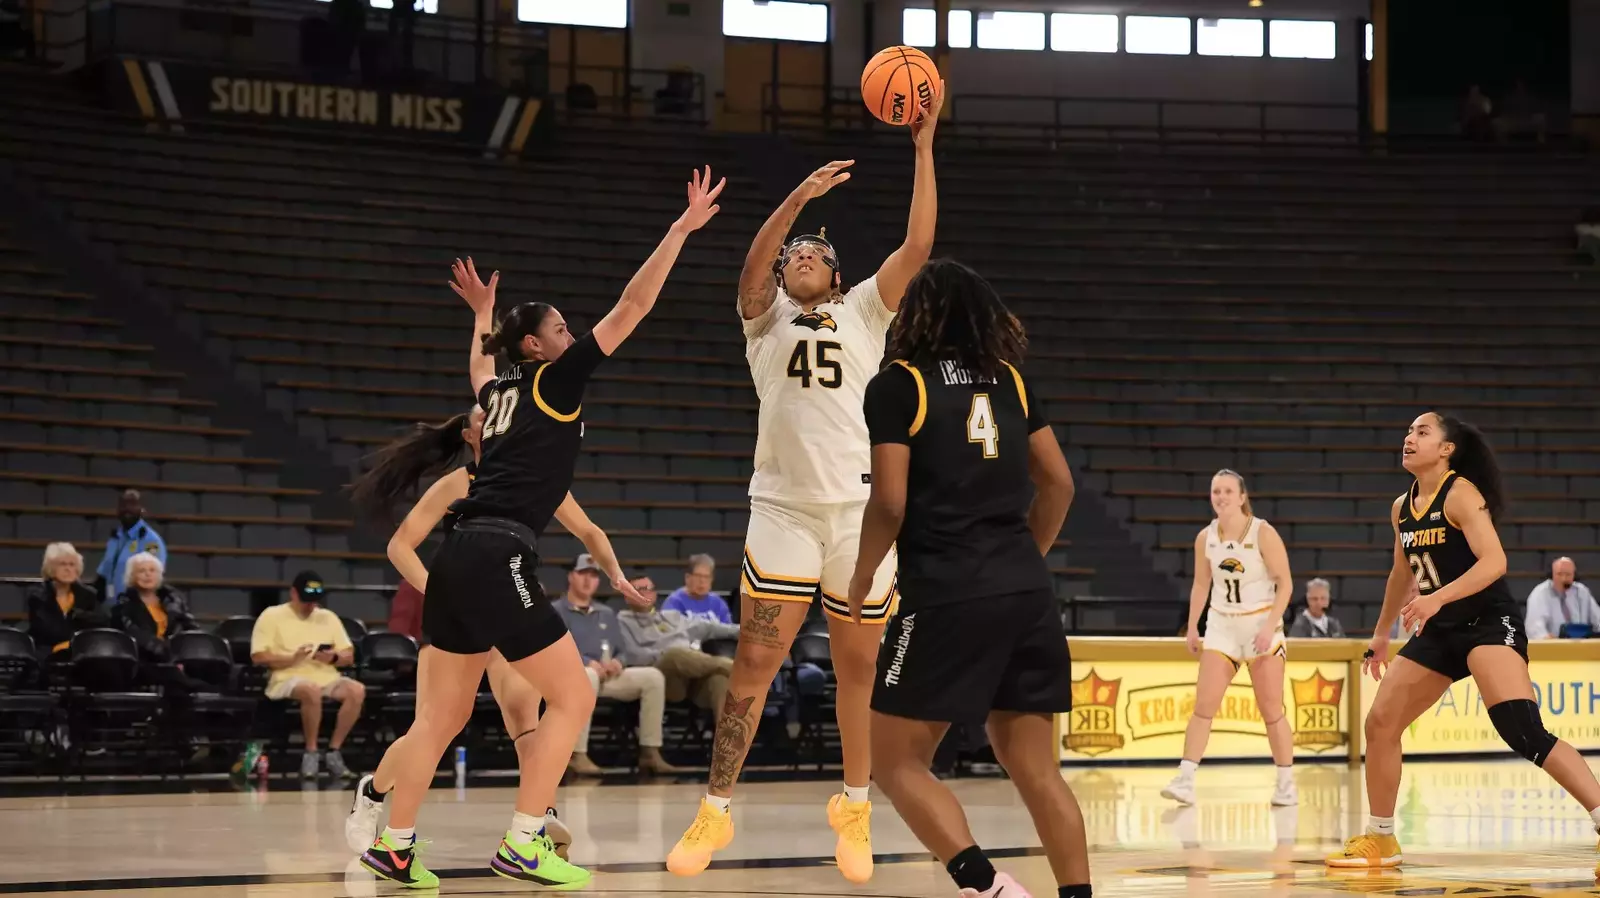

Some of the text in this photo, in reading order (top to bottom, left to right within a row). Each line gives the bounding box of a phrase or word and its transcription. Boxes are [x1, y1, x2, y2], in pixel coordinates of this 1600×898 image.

[209, 77, 462, 132] SOUTHERN MISS
[787, 340, 842, 388] 45
[481, 386, 520, 441] 20
[967, 393, 999, 459] 4
[509, 553, 534, 608] Mountaineers
[1224, 578, 1241, 603] 11
[1409, 552, 1442, 590] 21
[1139, 695, 1175, 726] KEG
[1432, 727, 1499, 742] COOLING
